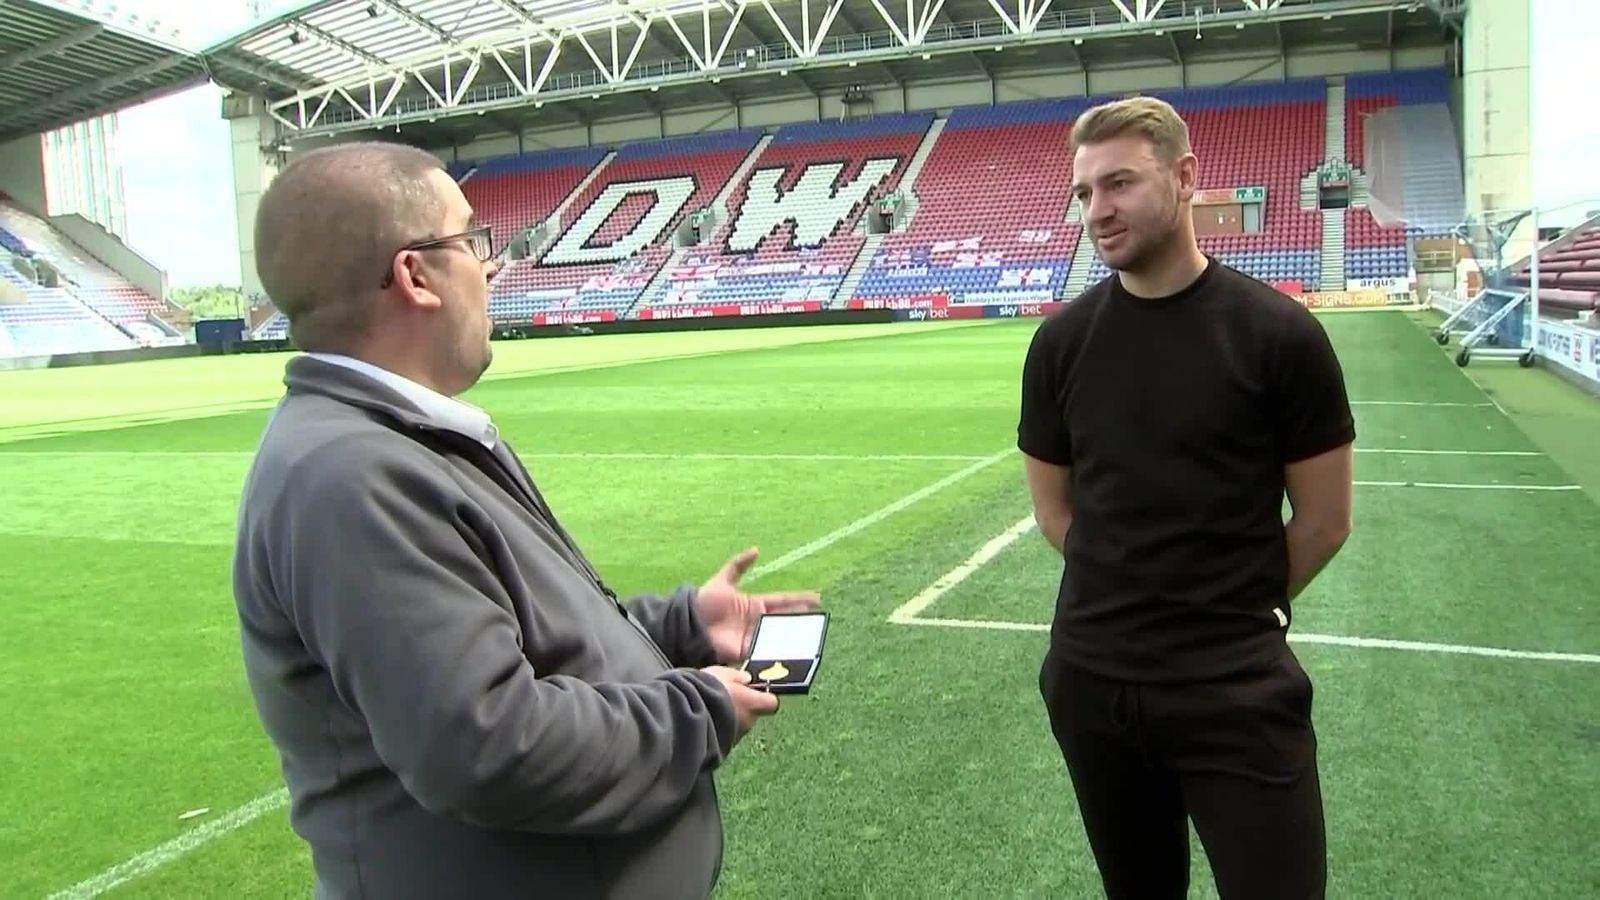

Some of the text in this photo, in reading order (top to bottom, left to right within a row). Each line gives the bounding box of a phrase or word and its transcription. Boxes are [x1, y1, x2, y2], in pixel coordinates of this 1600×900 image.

[1289, 292, 1385, 306] M-SIGNS.COM
[909, 308, 950, 321] sky bet
[1000, 304, 1042, 318] sky bet
